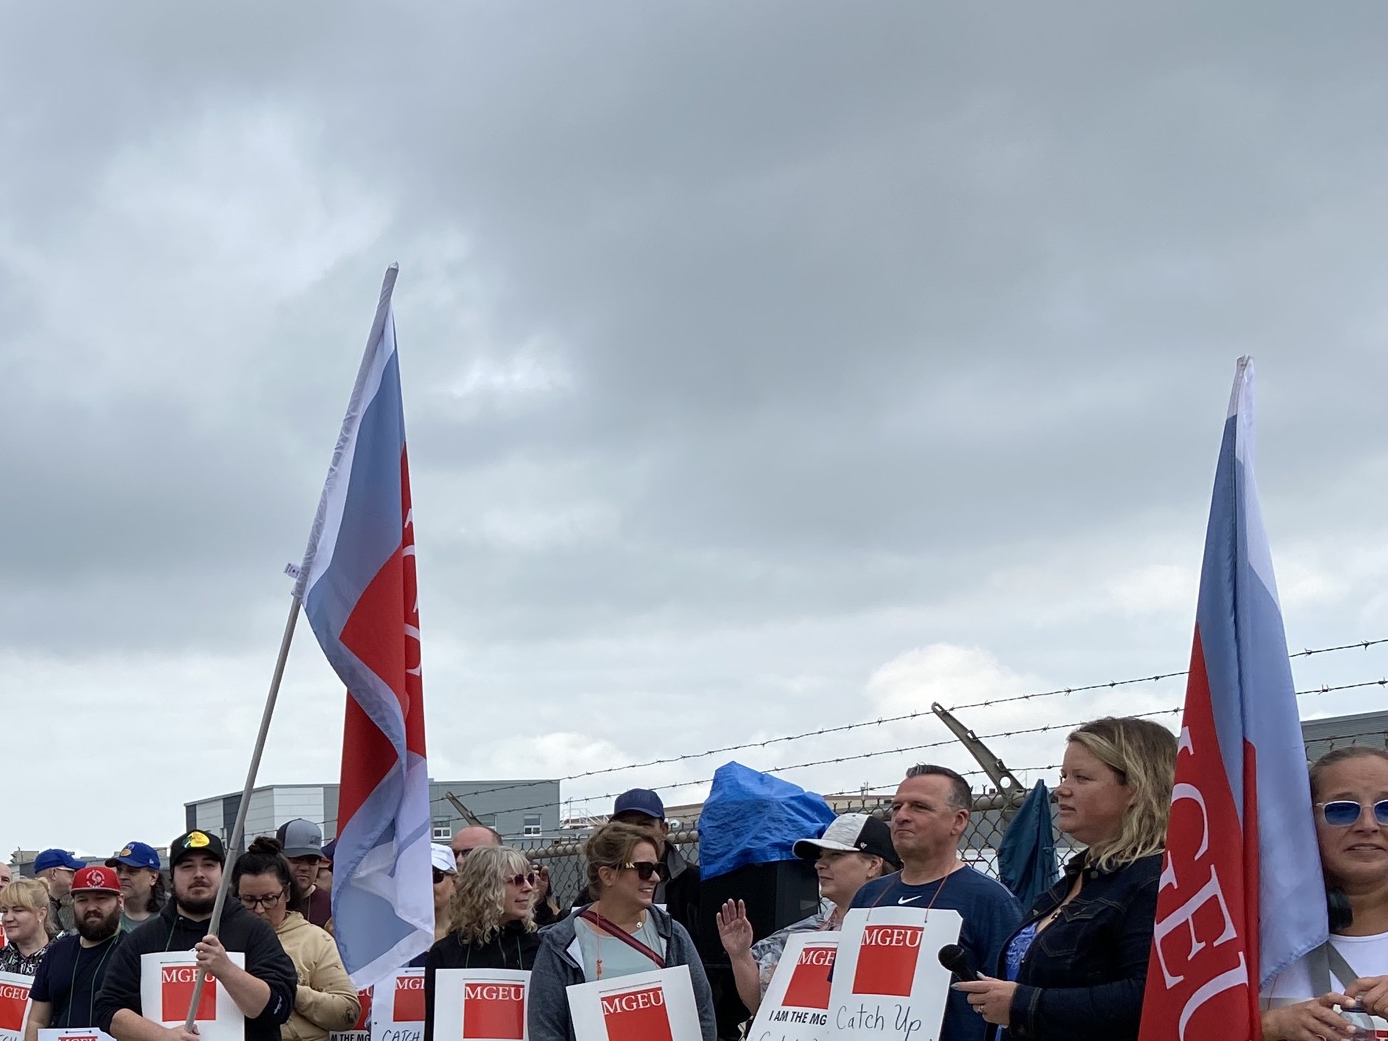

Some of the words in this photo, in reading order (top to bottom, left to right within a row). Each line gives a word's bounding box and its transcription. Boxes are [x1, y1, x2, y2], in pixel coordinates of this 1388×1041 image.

[861, 928, 923, 947] MGEU
[797, 950, 836, 966] MGE
[395, 978, 425, 990] MG
[465, 986, 525, 1000] MGEU
[601, 990, 664, 1016] MGEU
[769, 1010, 774, 1021] I
[774, 1011, 789, 1023] AM
[790, 1011, 808, 1024] THE
[809, 1013, 828, 1026] MG
[836, 1003, 885, 1031] Catch
[895, 1004, 922, 1041] Up
